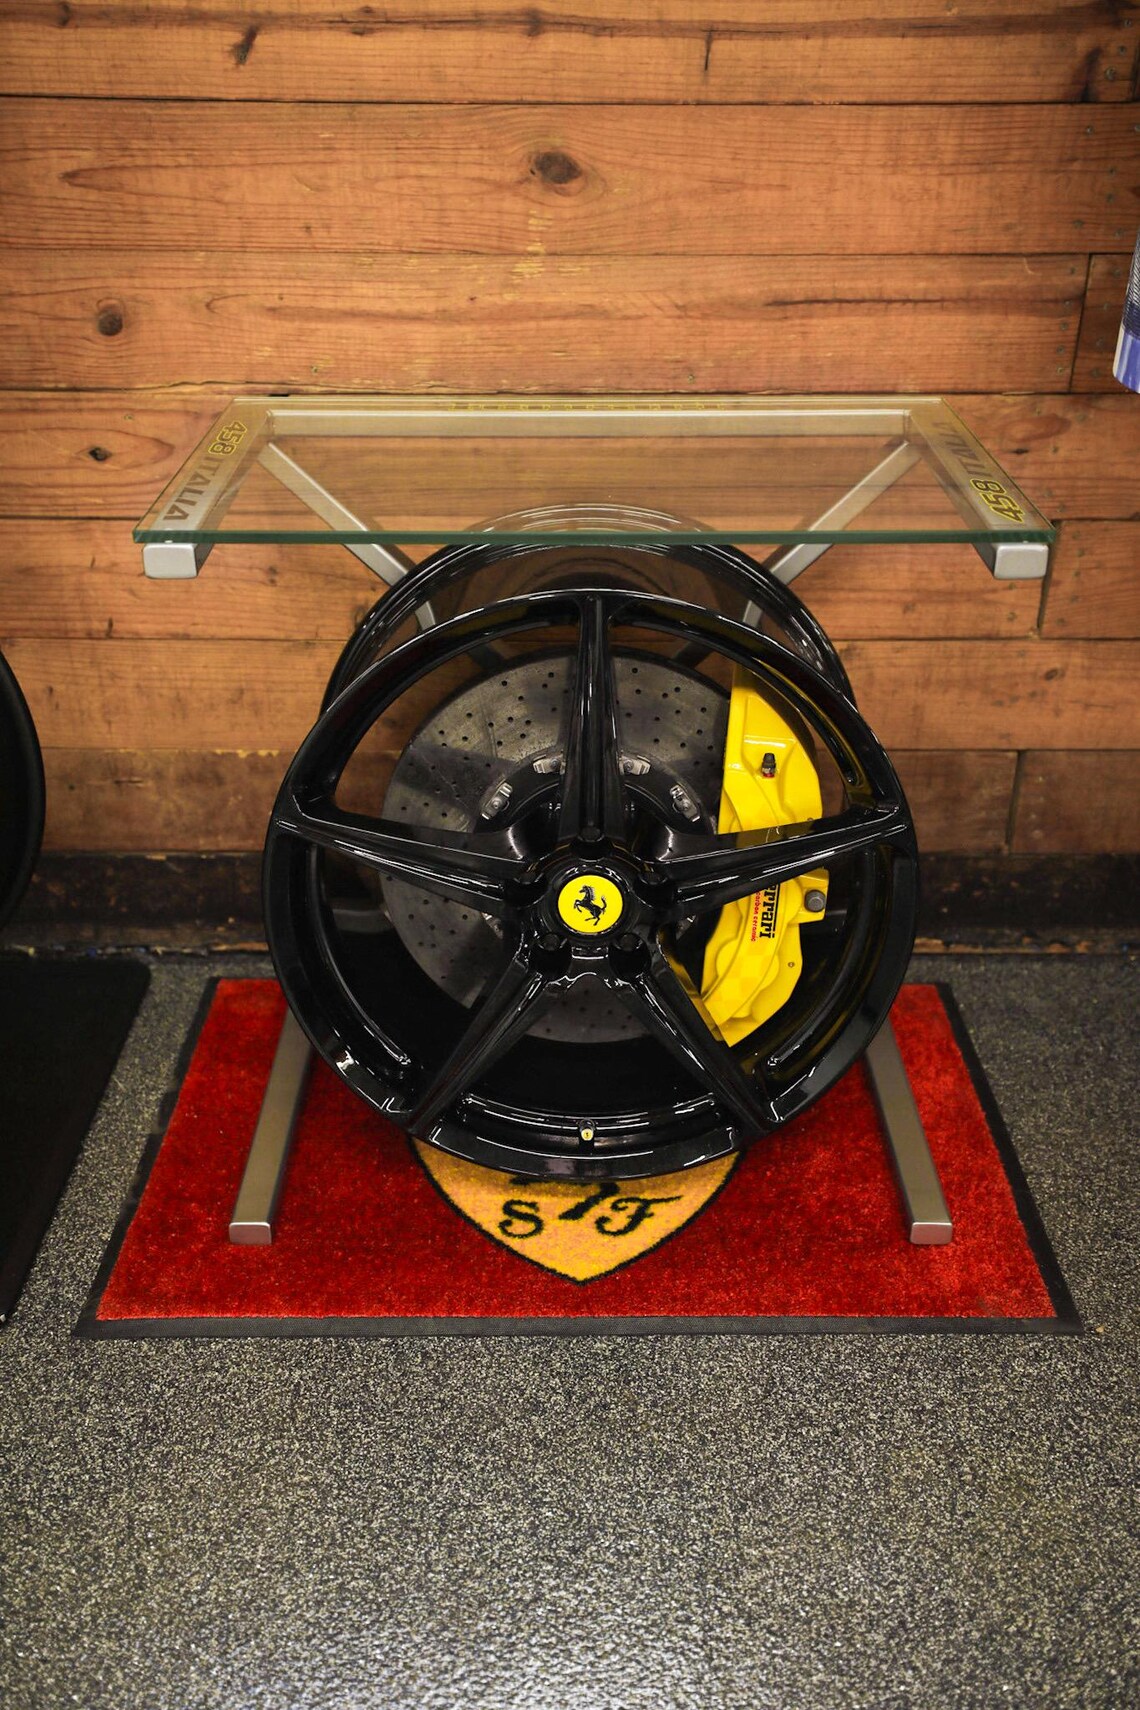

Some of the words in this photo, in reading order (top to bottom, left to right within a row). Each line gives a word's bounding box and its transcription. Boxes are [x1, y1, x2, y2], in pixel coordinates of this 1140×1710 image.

[208, 421, 248, 455] 458
[163, 456, 224, 520] ITALIA
[970, 478, 1025, 523] 458
[759, 884, 780, 939] errari
